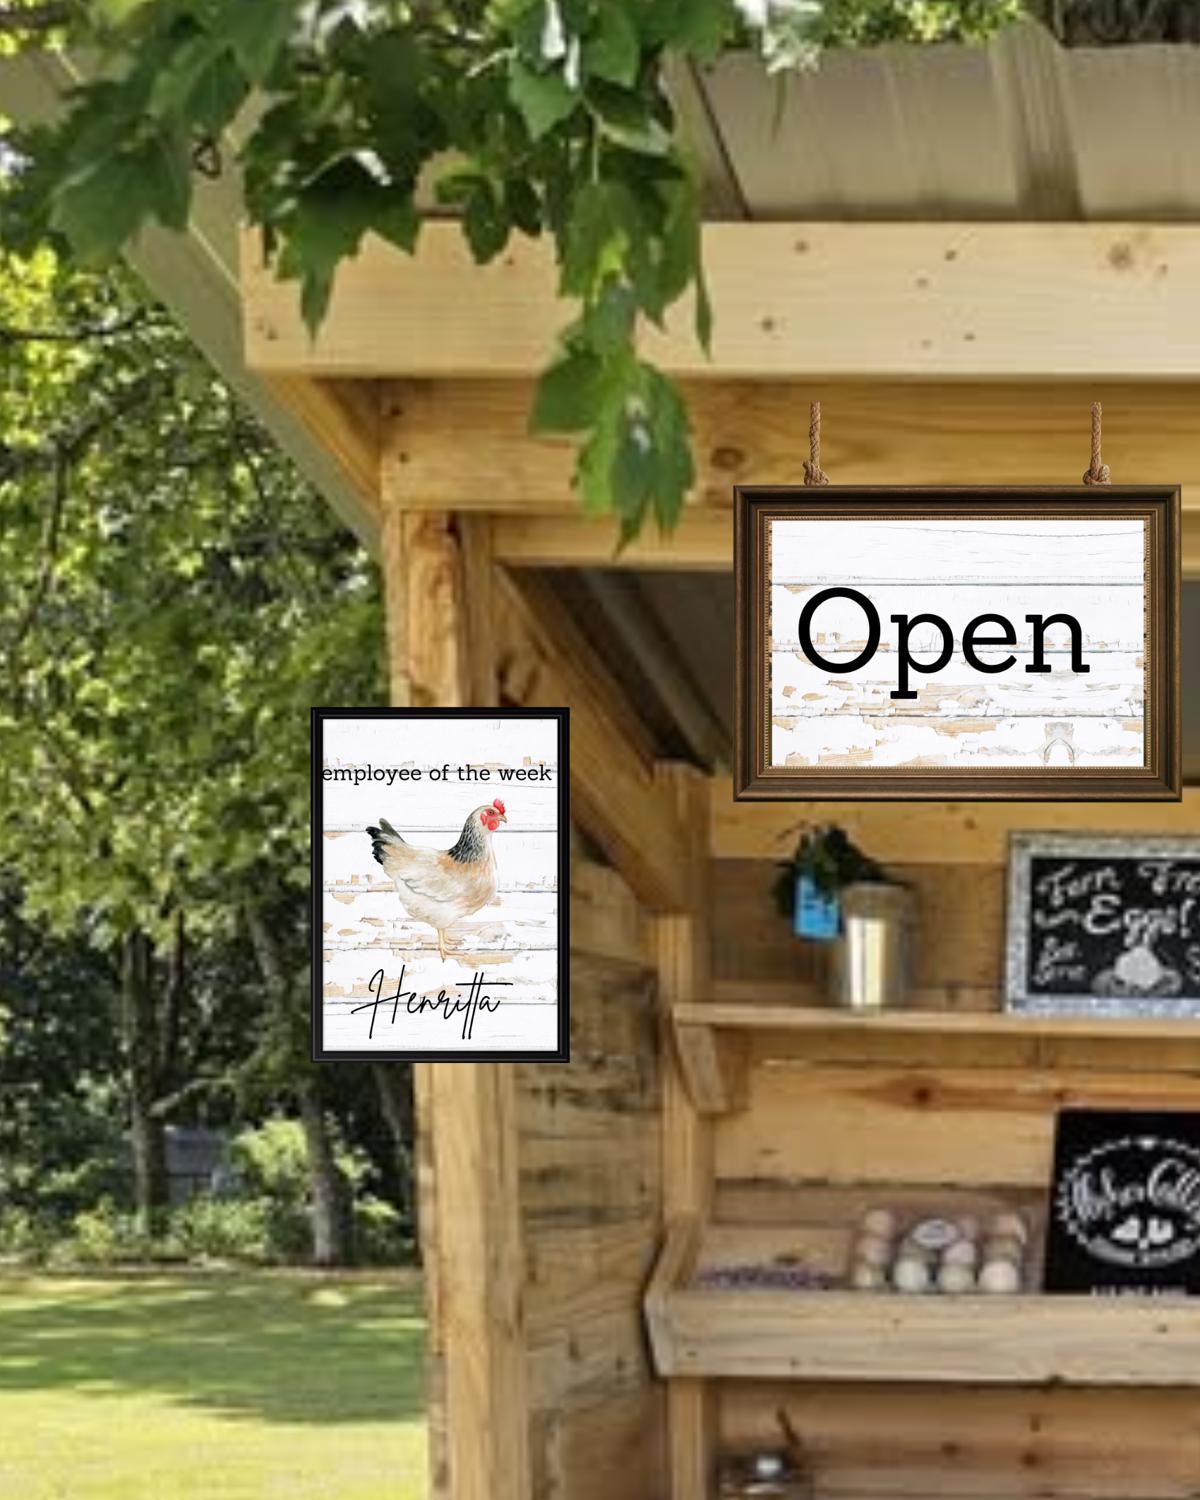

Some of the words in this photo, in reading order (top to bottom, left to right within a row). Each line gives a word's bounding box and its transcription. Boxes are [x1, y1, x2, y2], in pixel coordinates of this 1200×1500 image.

[798, 586, 1091, 700] Open
[323, 763, 422, 786] employee
[429, 763, 450, 781] of
[456, 764, 491, 781] the
[497, 763, 552, 781] week
[350, 964, 514, 1040] Henritta
